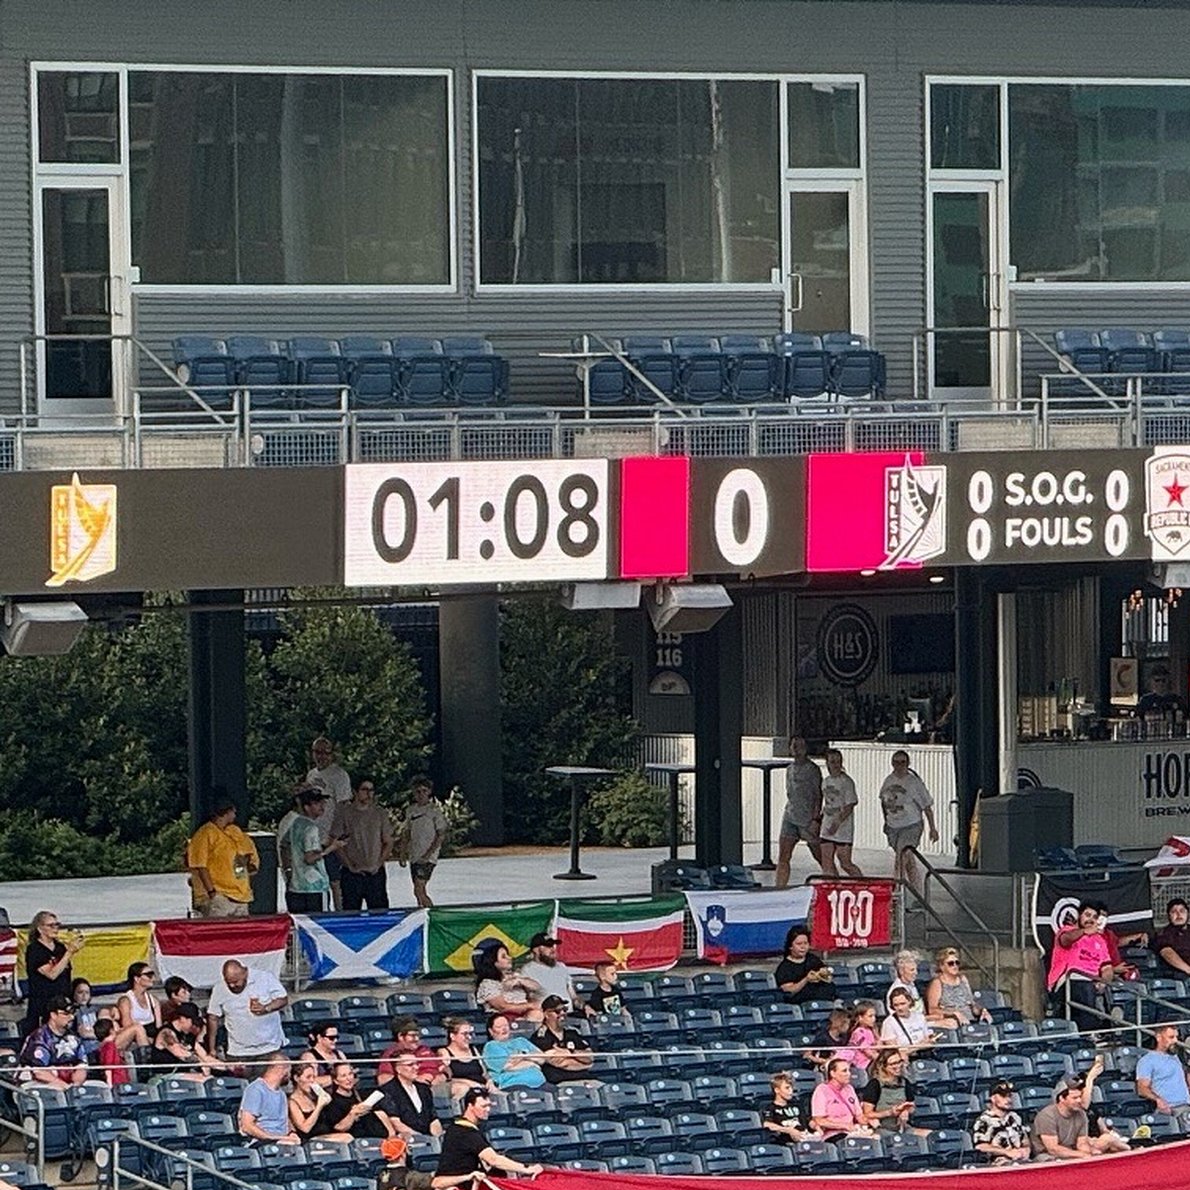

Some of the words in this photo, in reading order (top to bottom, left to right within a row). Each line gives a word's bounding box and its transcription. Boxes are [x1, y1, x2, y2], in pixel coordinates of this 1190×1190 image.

[889, 474, 900, 548] TULSA
[968, 470, 993, 514] 0
[1005, 471, 1094, 506] S.O.G.
[1105, 469, 1130, 512] 0
[370, 473, 600, 564] 01:08
[714, 468, 769, 566] 0
[967, 518, 992, 561] 0
[1005, 516, 1094, 548] FOULS
[1104, 513, 1129, 557] 0
[656, 649, 683, 667] 116
[833, 632, 862, 660] H&S
[827, 889, 875, 938] 100
